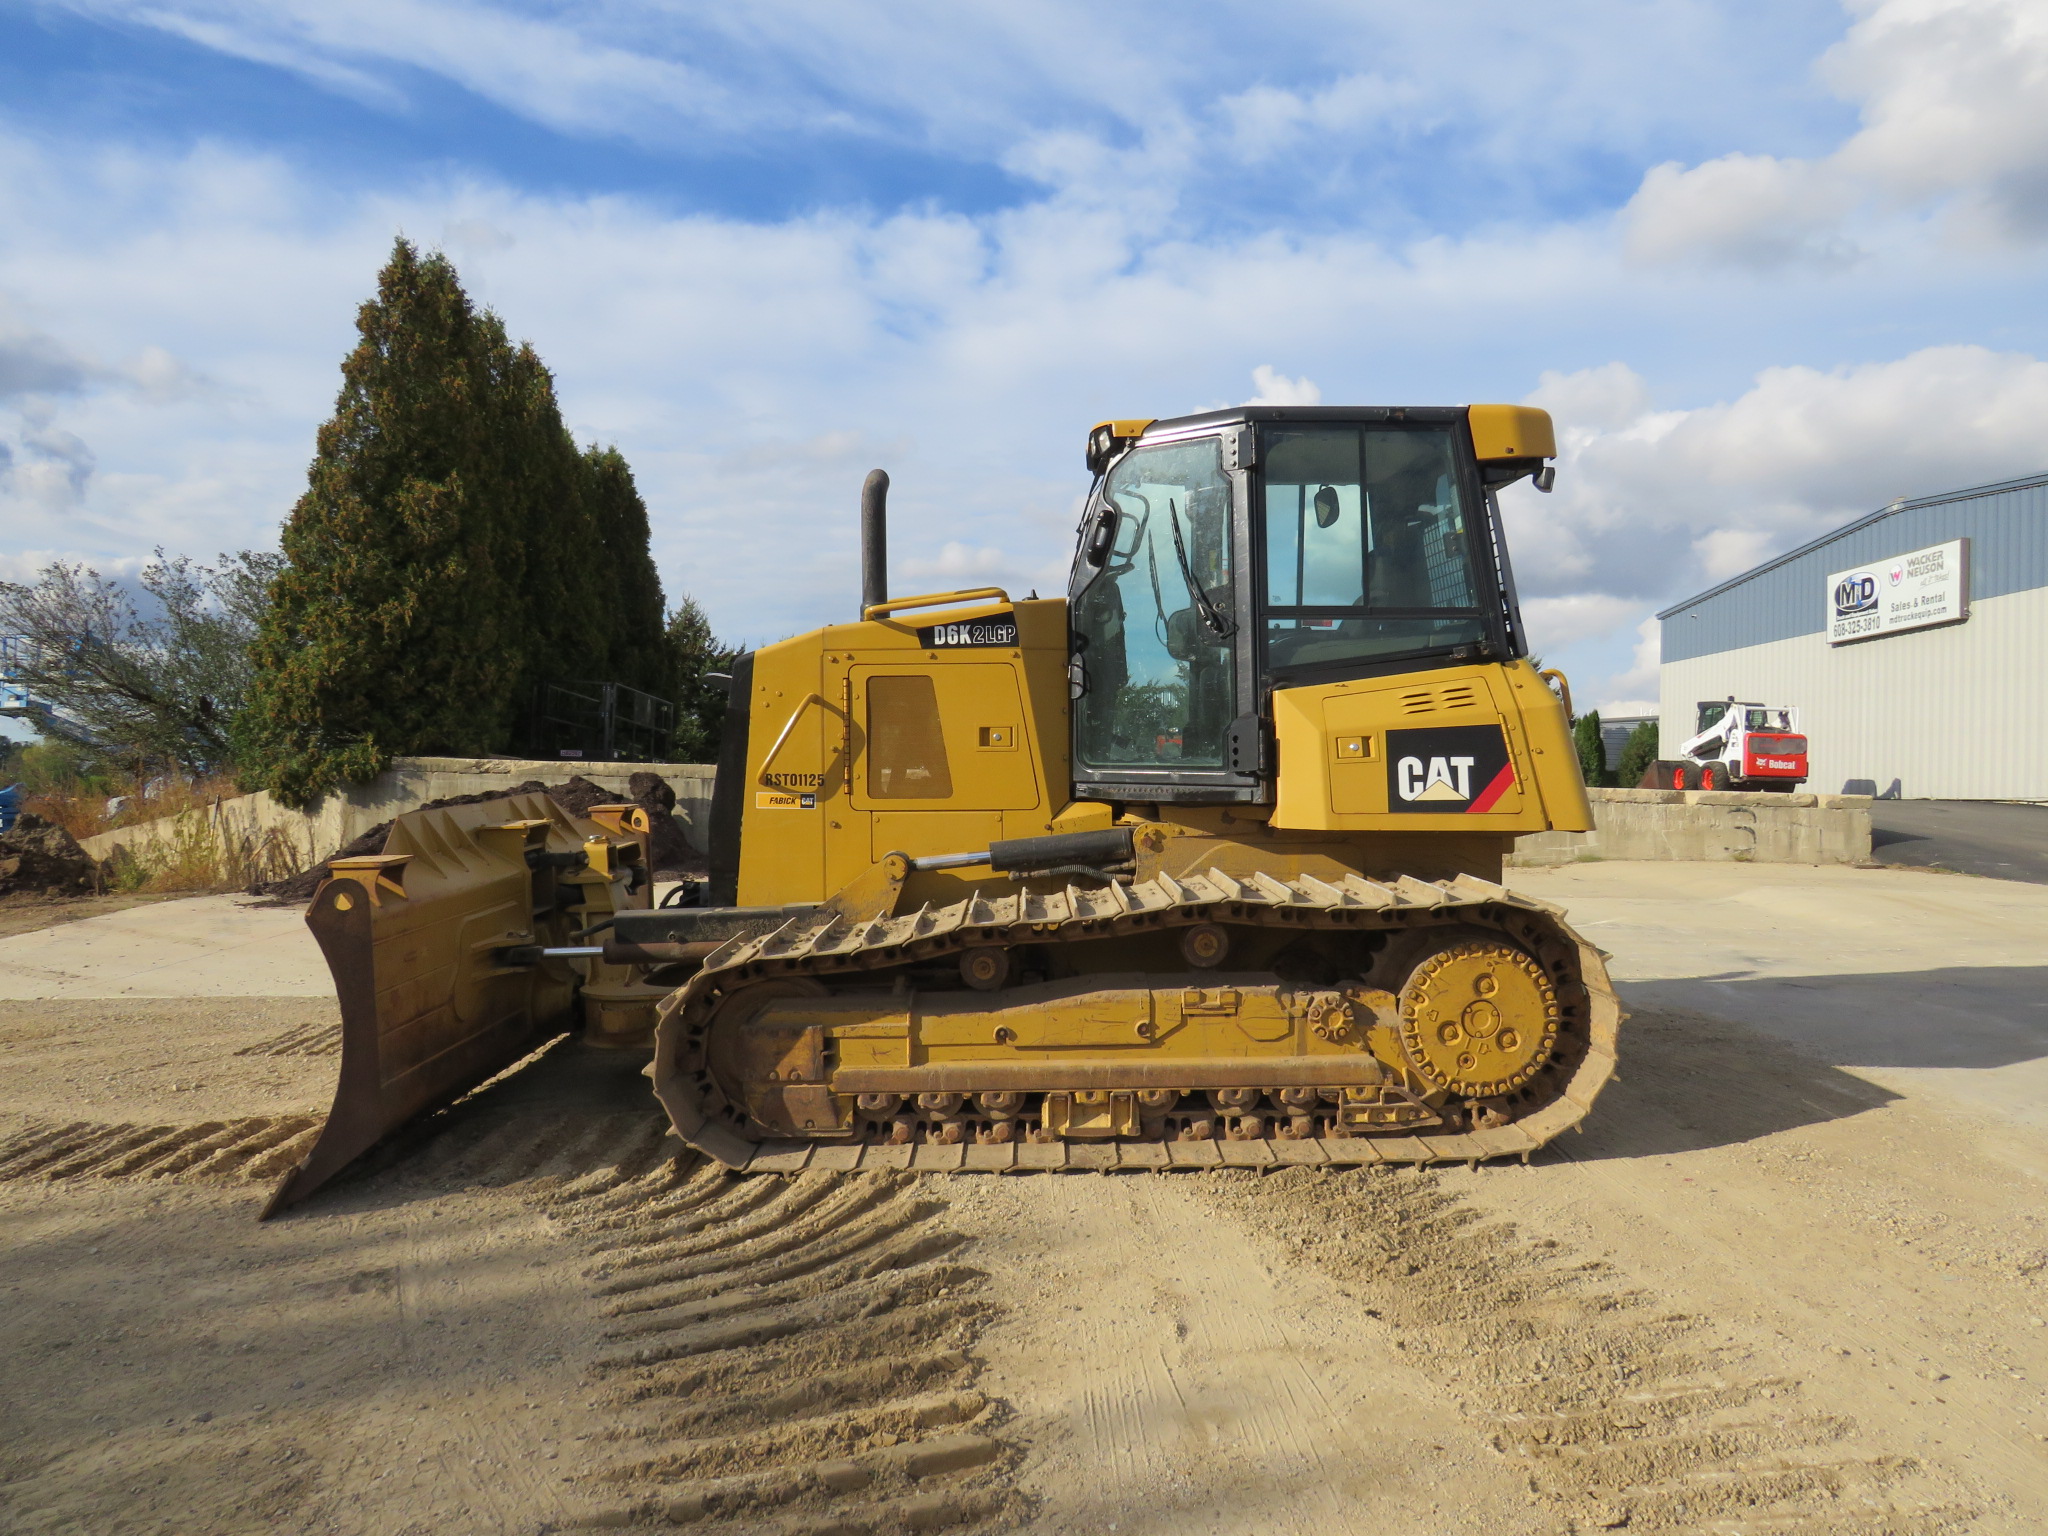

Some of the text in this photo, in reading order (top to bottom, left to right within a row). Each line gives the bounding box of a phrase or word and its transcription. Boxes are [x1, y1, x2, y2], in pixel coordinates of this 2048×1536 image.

[1906, 550, 1944, 568] WACKER
[1906, 560, 1944, 579] NEUSON
[1890, 591, 1946, 613] Sales & Rental
[1889, 606, 1948, 624] mdtruckequip.com
[1833, 615, 1881, 637] 608-325-3810
[1768, 759, 1796, 770] Bobcat
[765, 773, 825, 787] RST01125
[1397, 756, 1475, 802] CAT
[769, 796, 814, 806] FABICK CAT
